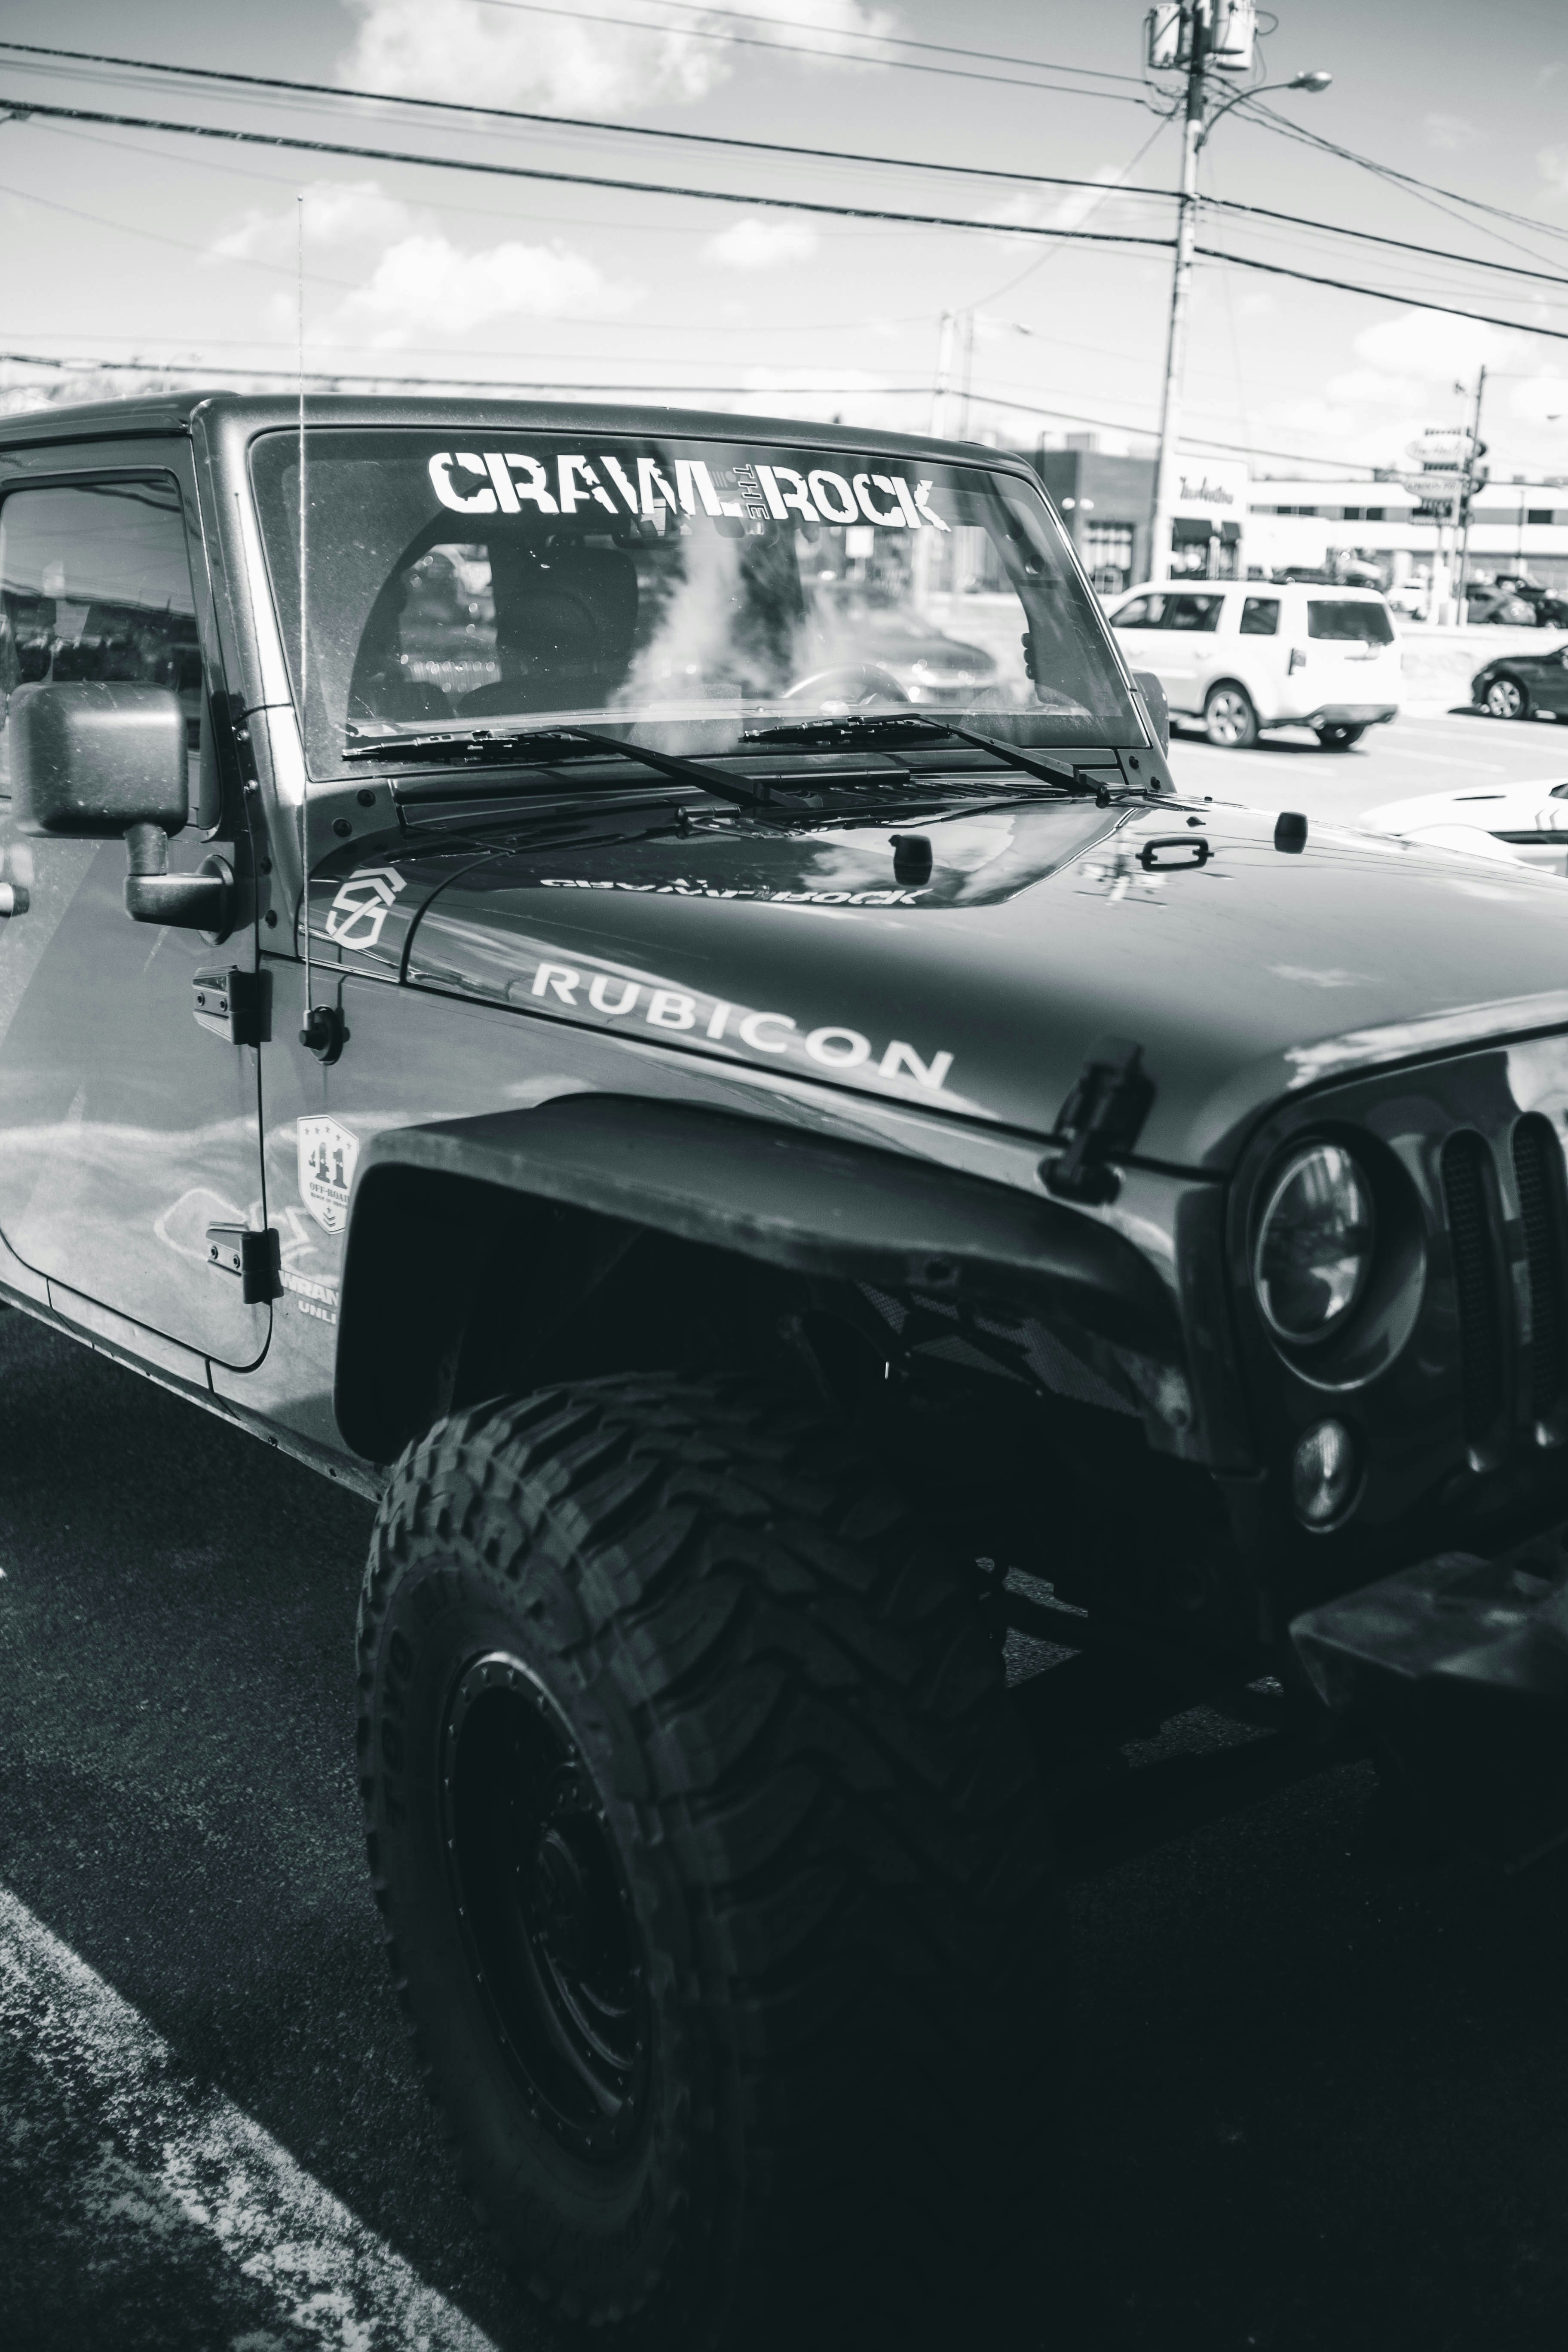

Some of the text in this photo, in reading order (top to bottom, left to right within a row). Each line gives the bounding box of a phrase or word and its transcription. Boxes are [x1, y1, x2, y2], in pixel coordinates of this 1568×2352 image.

[429, 452, 951, 532] CRAWL THE ROCK
[531, 962, 954, 1090] RUBICON
